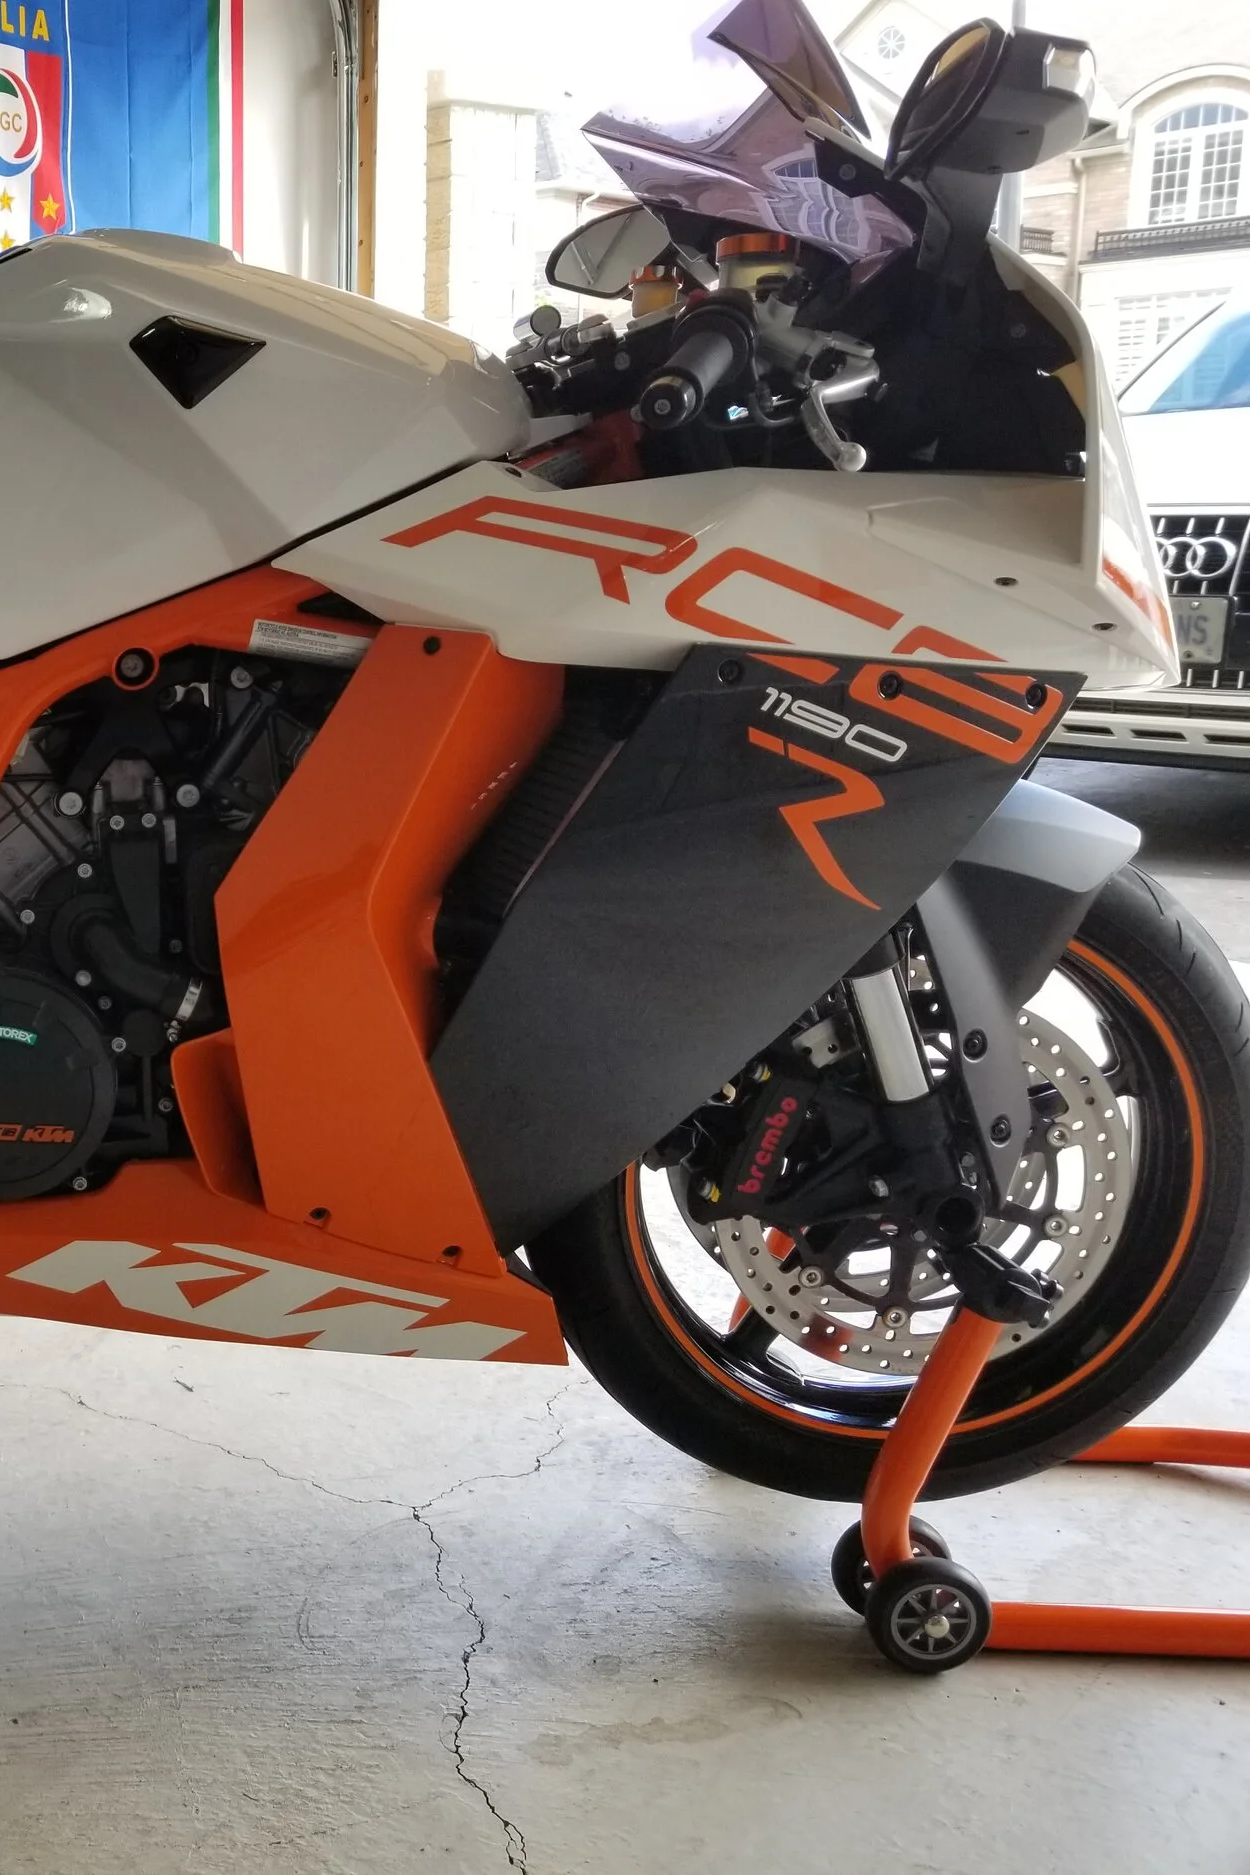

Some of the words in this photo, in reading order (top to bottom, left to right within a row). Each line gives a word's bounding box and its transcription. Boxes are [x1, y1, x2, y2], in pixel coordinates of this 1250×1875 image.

[759, 686, 908, 763] 1190
[21, 1125, 75, 1143] KTM
[735, 1096, 798, 1194] brembo
[5, 1240, 528, 1361] KTM
